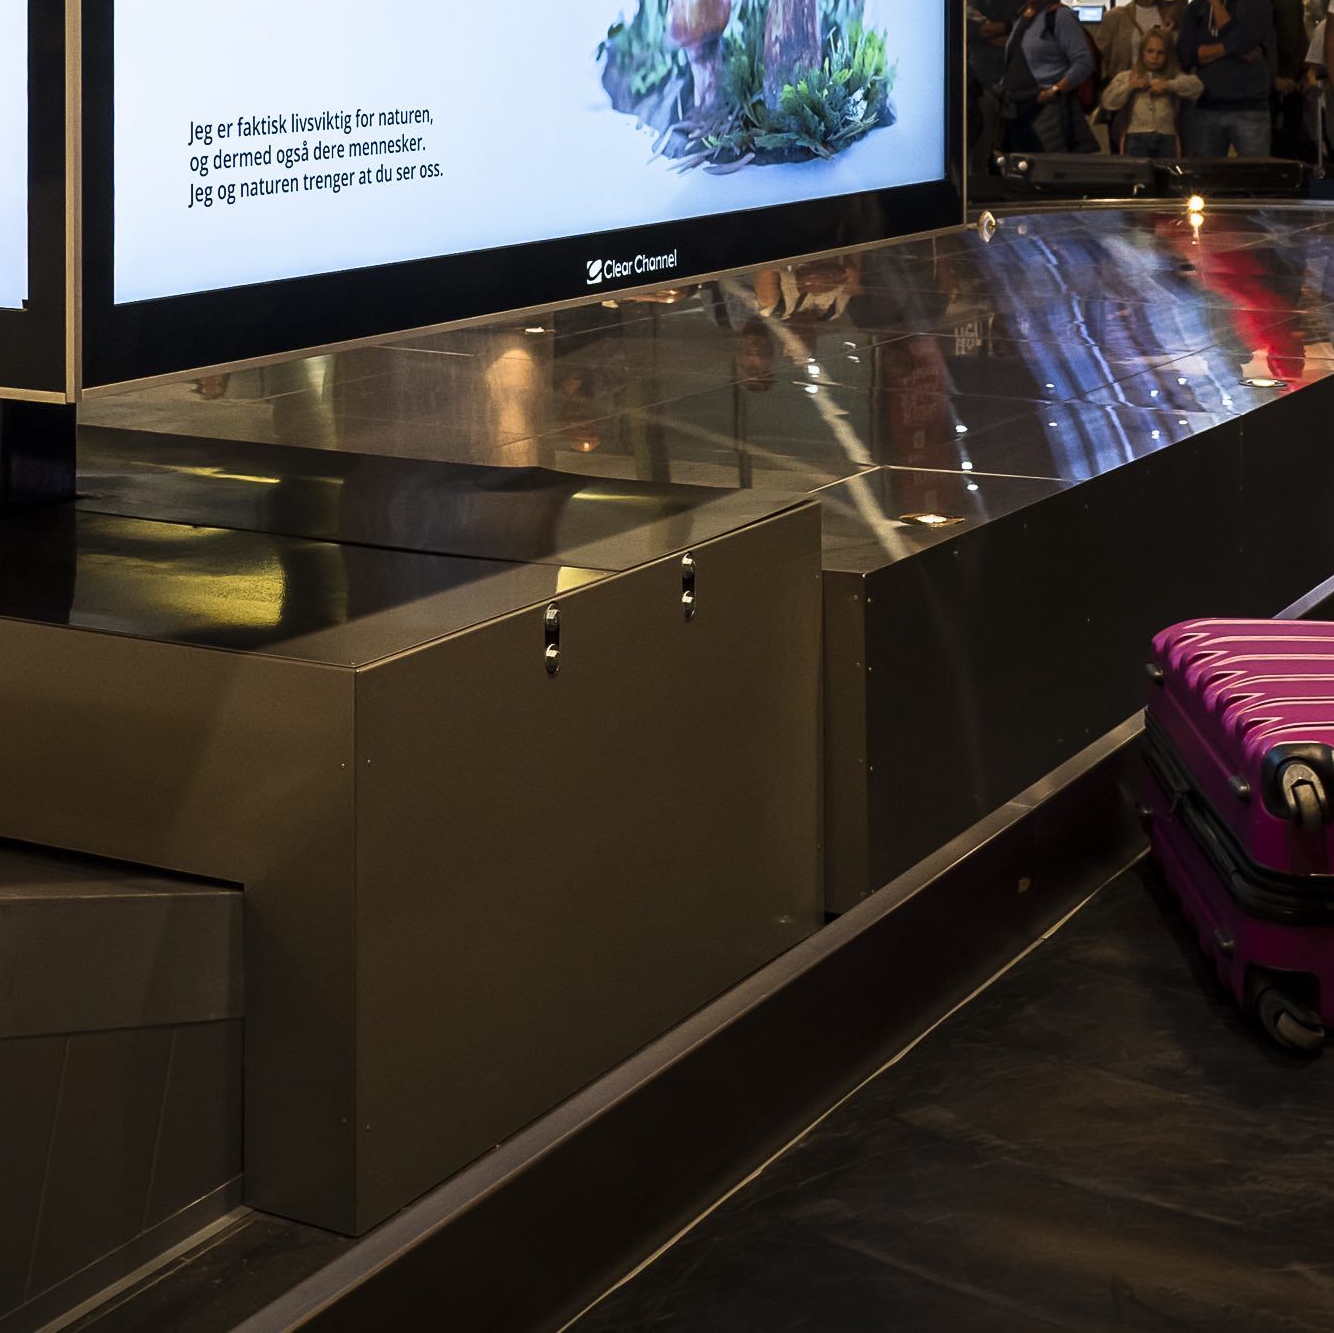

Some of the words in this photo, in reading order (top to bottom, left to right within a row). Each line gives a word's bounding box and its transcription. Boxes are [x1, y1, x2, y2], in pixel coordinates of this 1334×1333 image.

[188, 120, 213, 146] Jeg
[217, 123, 233, 139] er
[237, 114, 287, 137] faktisk
[290, 110, 352, 134] livsviktig
[355, 108, 376, 128] for
[378, 107, 434, 126] naturen,
[189, 154, 209, 177] og
[213, 144, 272, 170] dermed
[276, 140, 309, 168] også
[313, 140, 345, 160] dere
[348, 133, 426, 157] mennesker.
[188, 182, 213, 208] Jeg
[217, 182, 236, 205] og
[240, 176, 299, 198] naturen
[303, 170, 356, 193] trenger
[358, 166, 372, 185] at
[375, 164, 393, 183] du
[396, 163, 416, 182] ser
[419, 162, 444, 179] oss.
[603, 259, 633, 279] Clear
[634, 249, 677, 273] Channel
